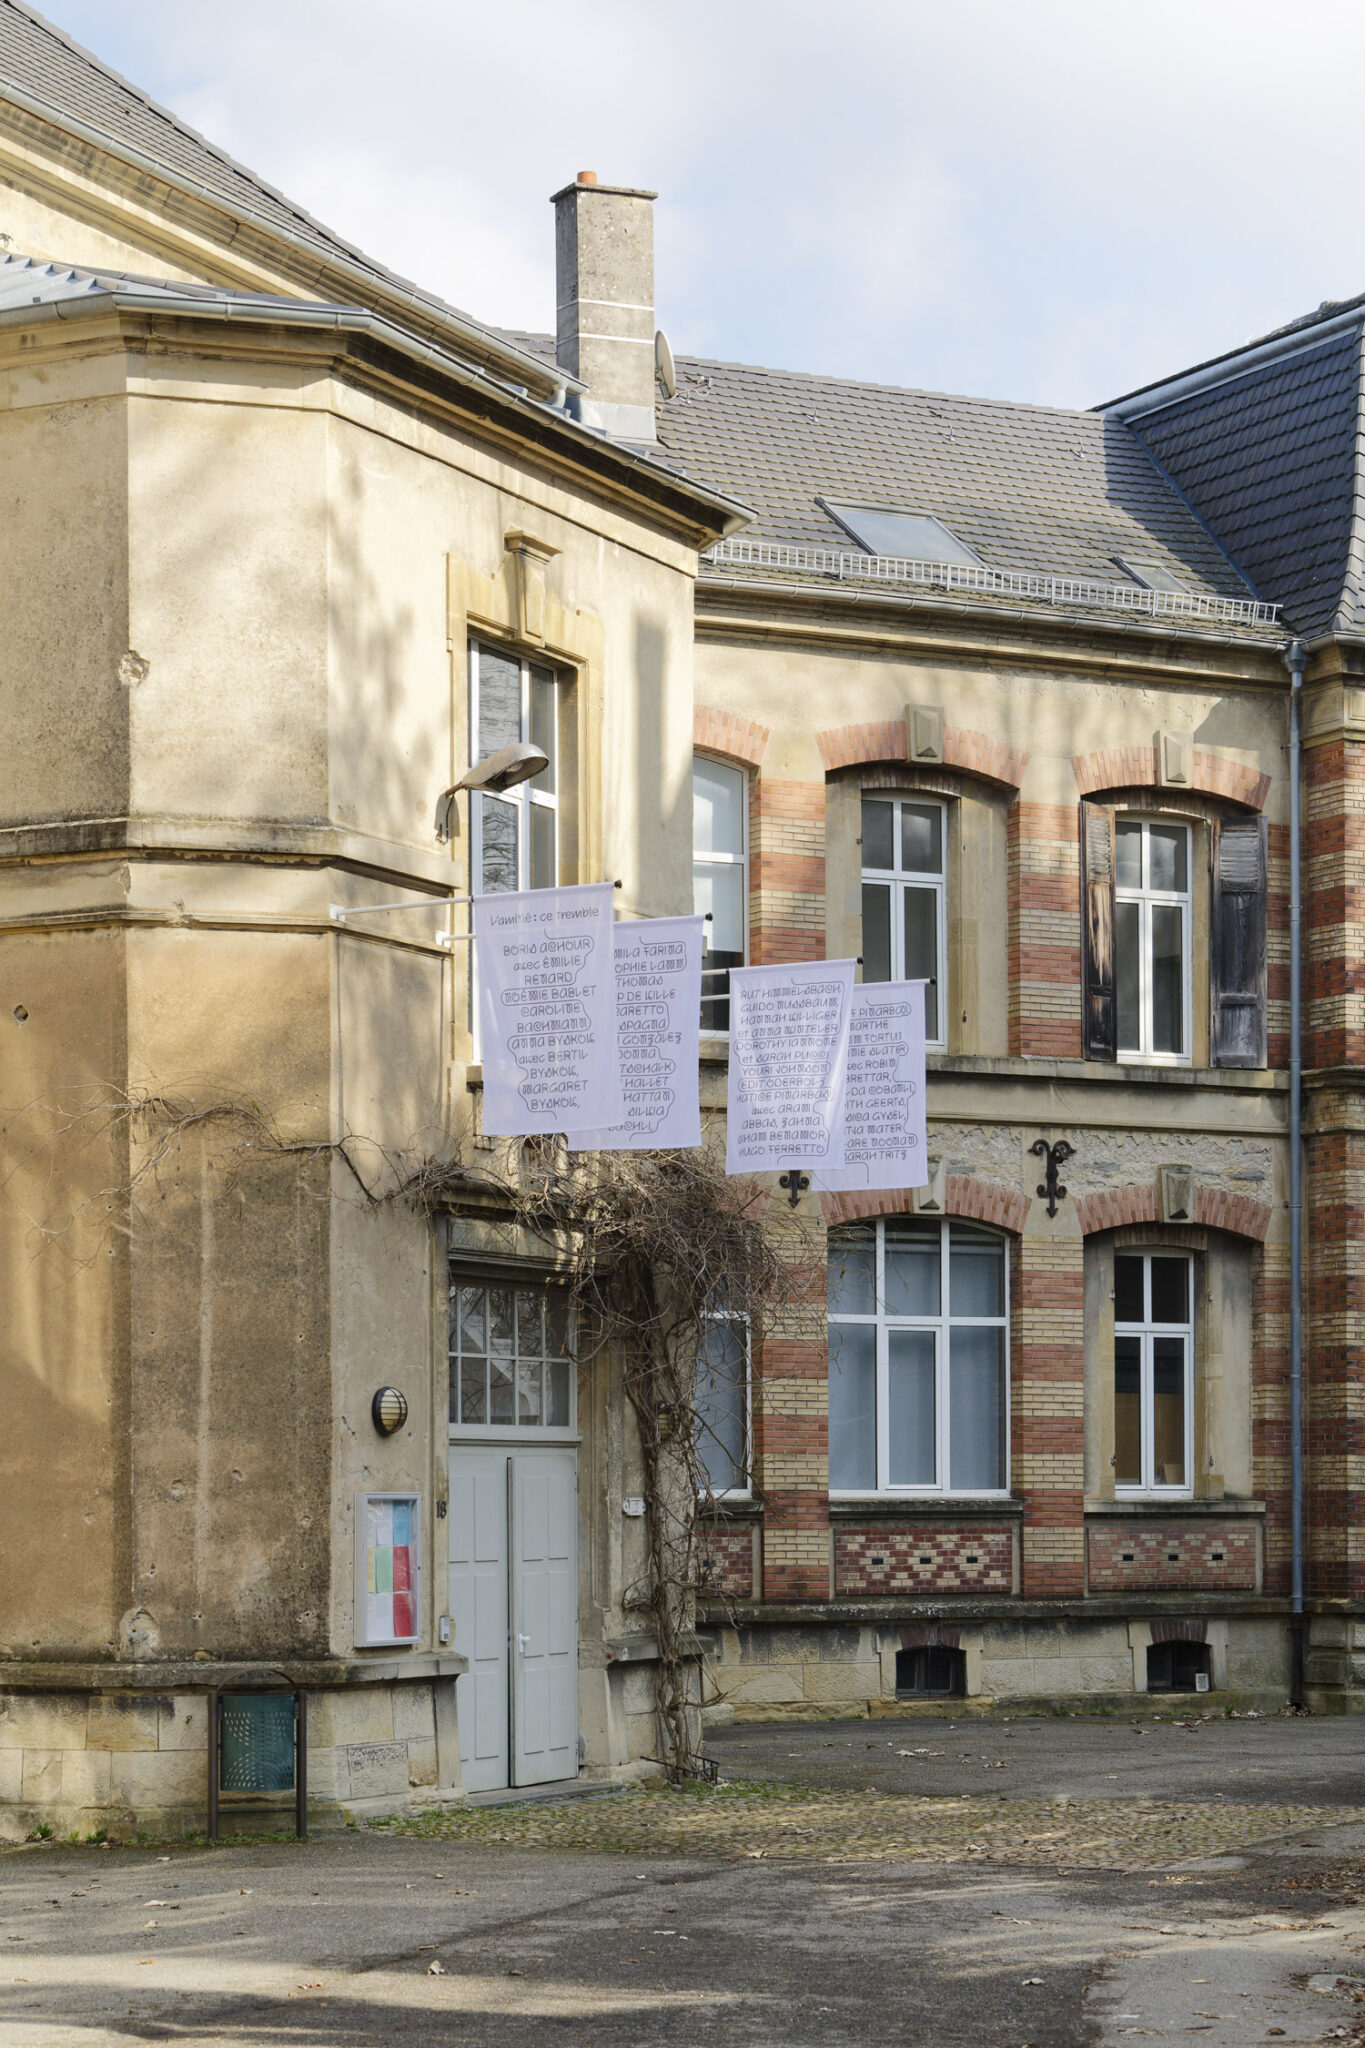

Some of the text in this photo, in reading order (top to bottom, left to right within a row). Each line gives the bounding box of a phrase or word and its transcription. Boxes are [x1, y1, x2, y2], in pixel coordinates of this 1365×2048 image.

[539, 912, 553, 922] ce
[737, 1029, 748, 1038] et
[742, 1055, 753, 1064] et
[436, 1500, 447, 1519] 18
